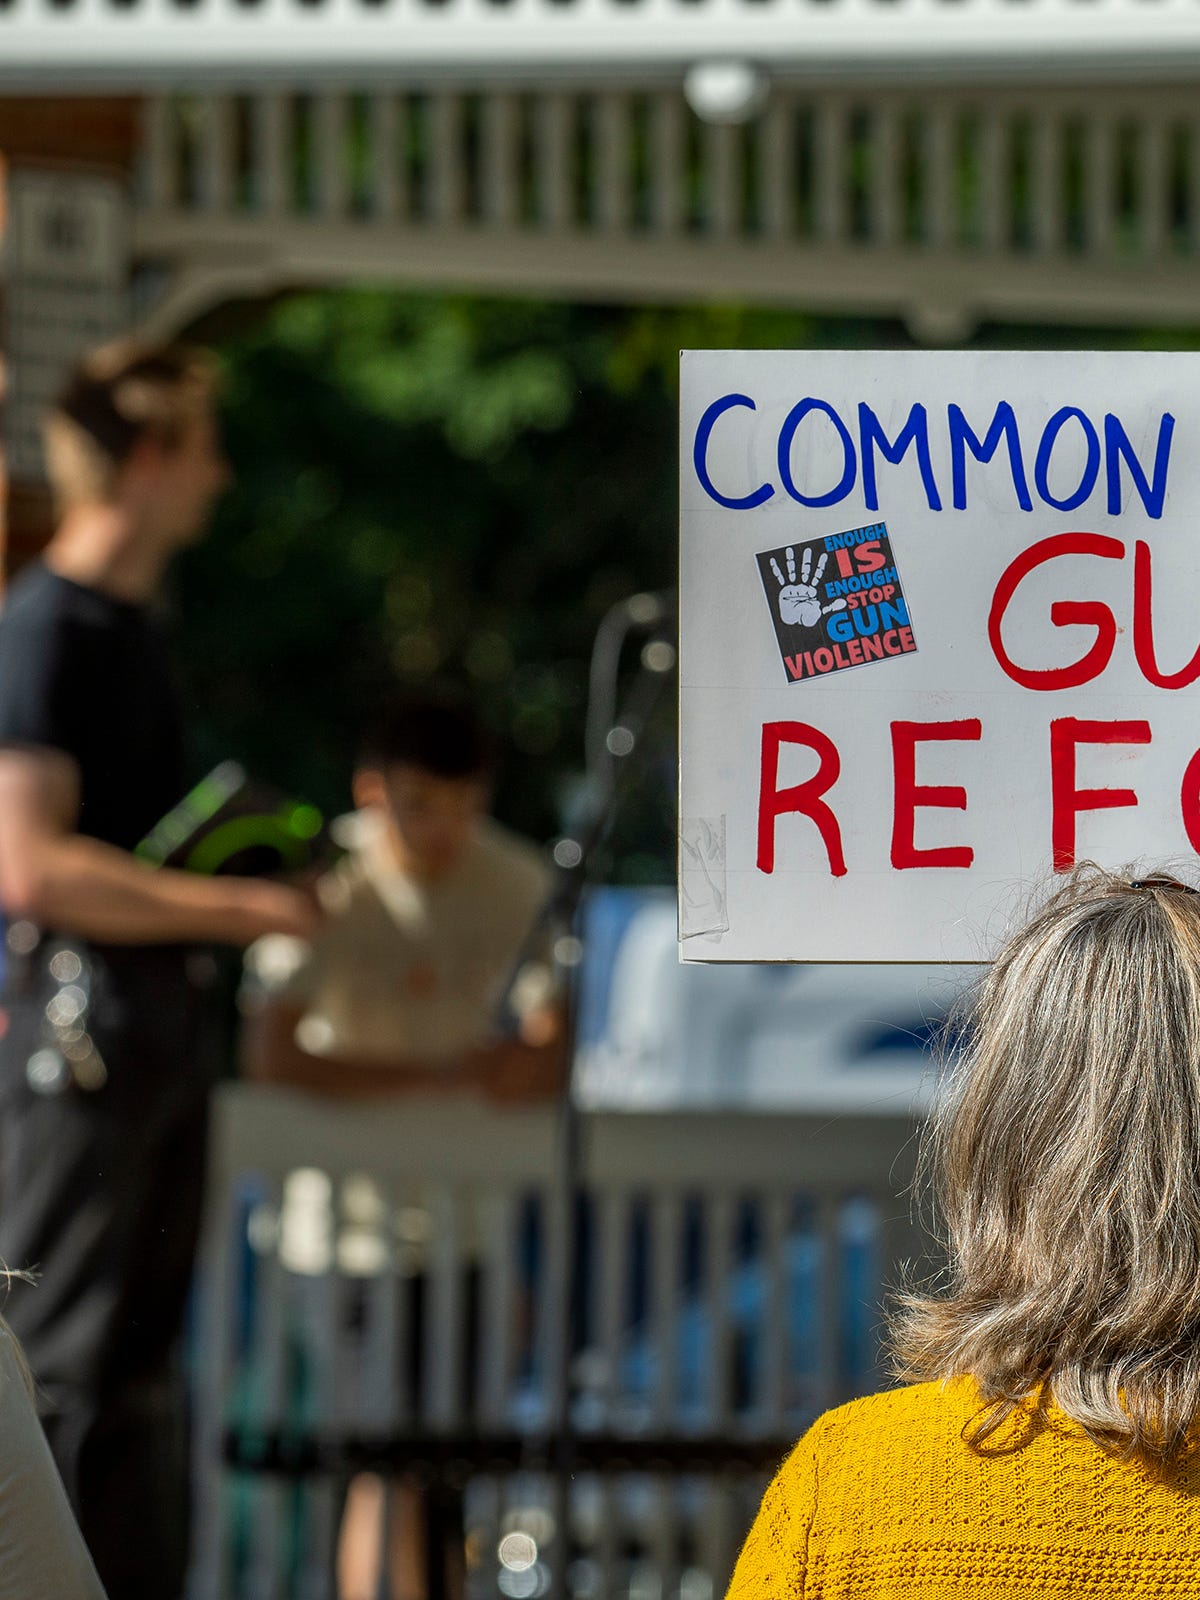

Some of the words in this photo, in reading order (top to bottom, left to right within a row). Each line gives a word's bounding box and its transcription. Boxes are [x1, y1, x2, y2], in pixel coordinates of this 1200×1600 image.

[693, 393, 1175, 520] COMMON
[824, 524, 888, 552] ENOUGH
[834, 540, 886, 578] IS
[825, 566, 899, 598] ENOUGH
[846, 584, 895, 610] STOP
[826, 597, 910, 643] GUN
[784, 626, 917, 680] VIOLENCE
